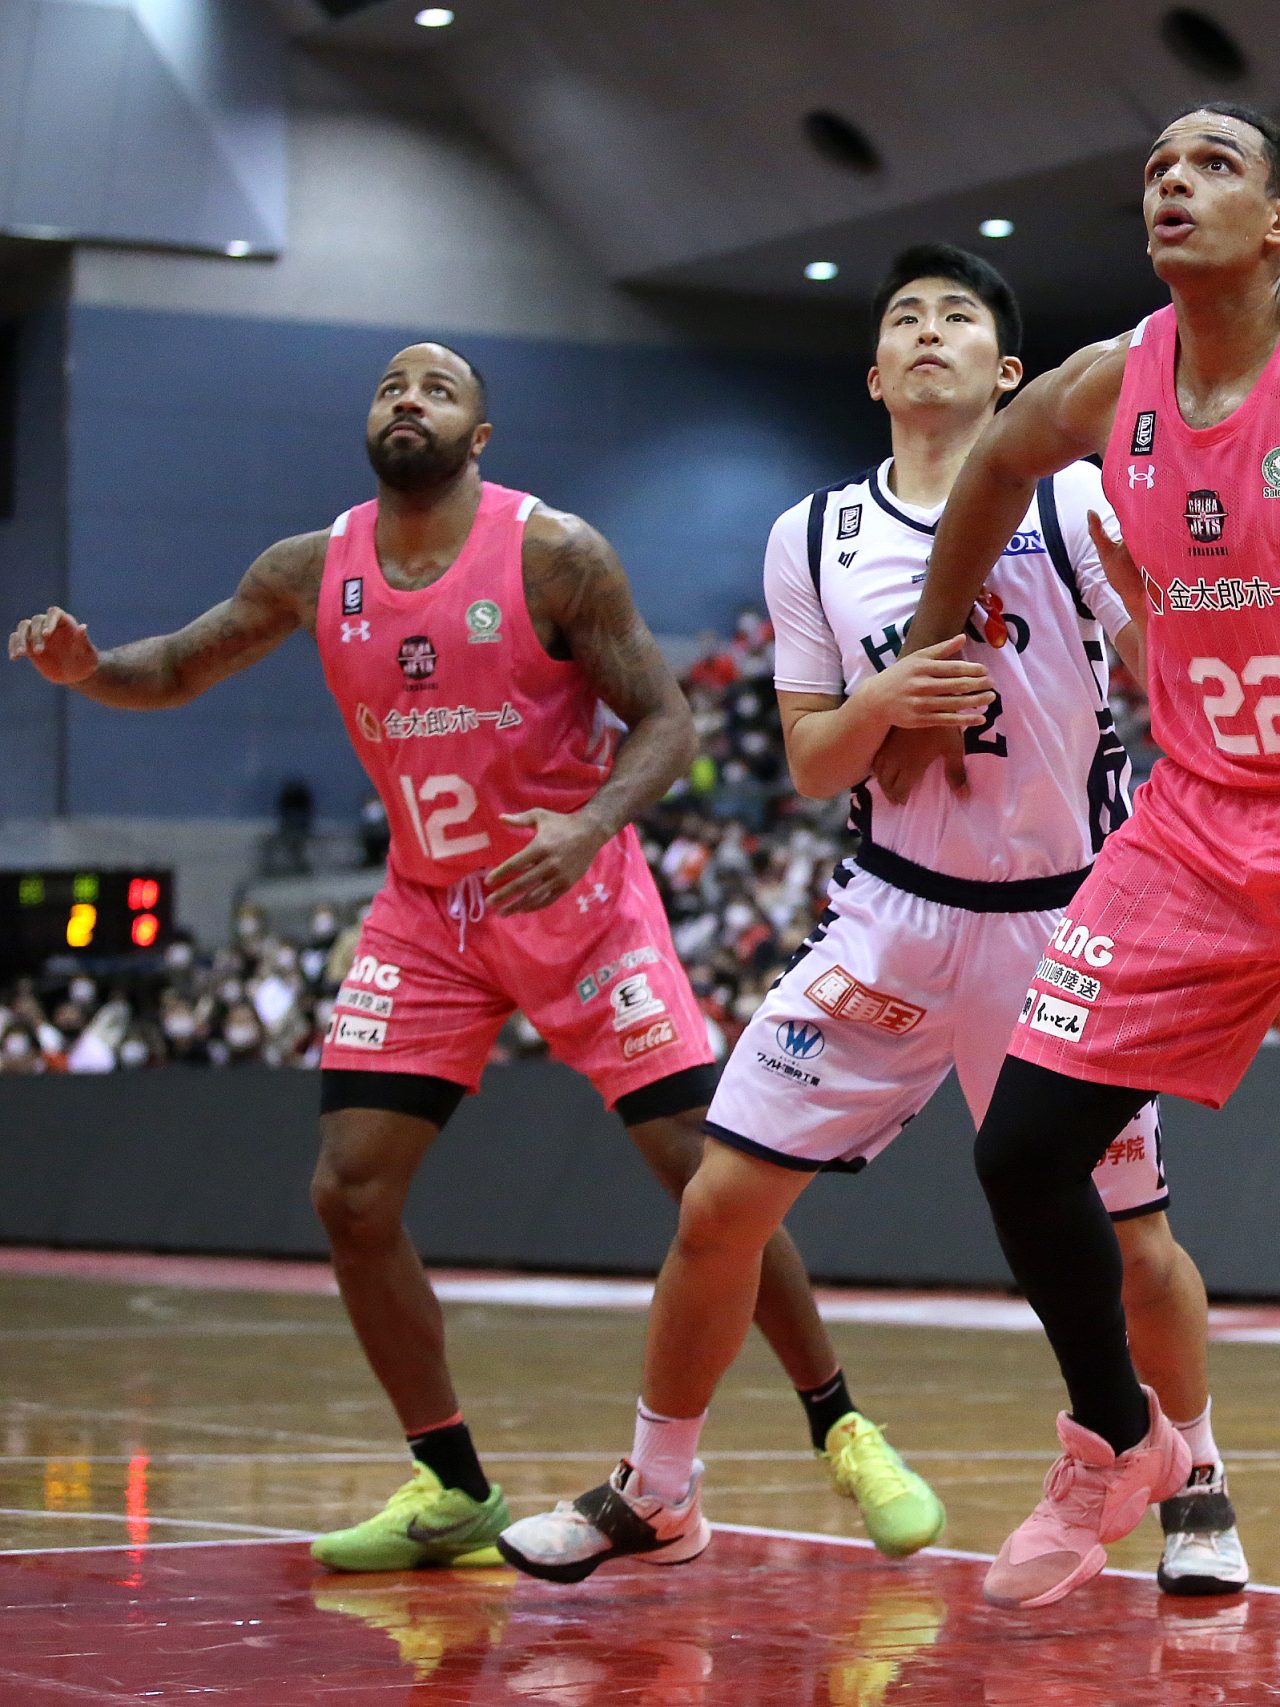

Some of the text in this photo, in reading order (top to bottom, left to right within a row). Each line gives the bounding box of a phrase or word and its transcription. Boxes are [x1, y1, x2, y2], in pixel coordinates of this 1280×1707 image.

[1003, 533, 1047, 552] ON
[383, 701, 522, 740] 金太郎ホーム
[400, 774, 492, 860] 12
[1037, 1002, 1080, 1033] くいどん
[1097, 1135, 1146, 1166] 学院
